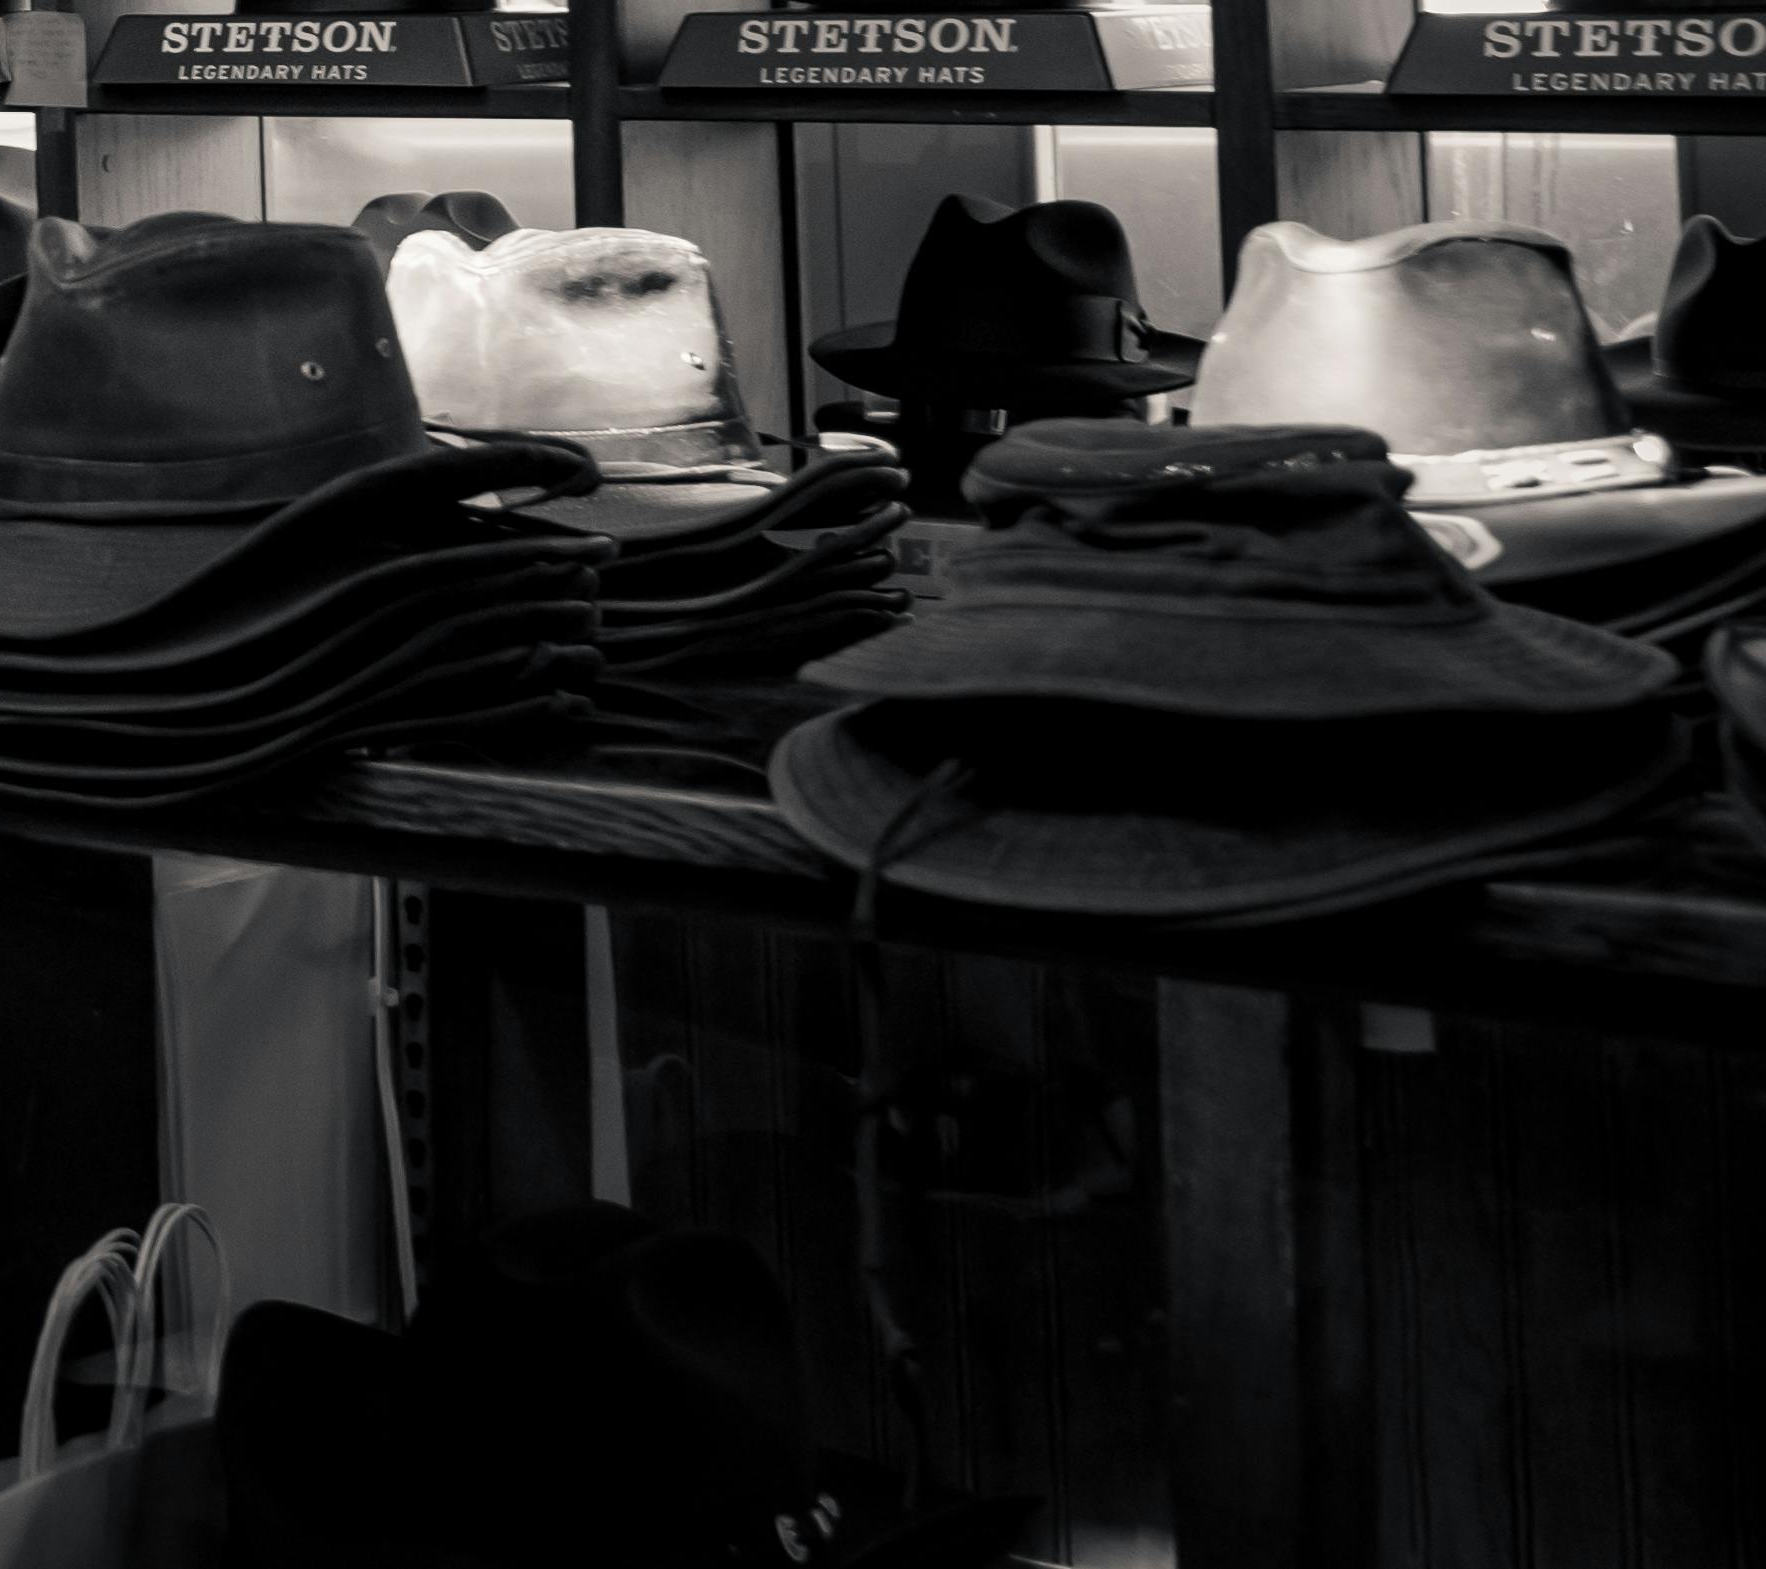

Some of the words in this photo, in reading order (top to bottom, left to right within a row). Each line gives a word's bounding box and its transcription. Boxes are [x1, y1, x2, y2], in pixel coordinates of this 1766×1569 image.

[161, 20, 398, 54] STETSON
[737, 17, 1019, 55] STETSON
[1482, 17, 1766, 59] STETSO
[177, 63, 305, 81] LEGENDARY
[310, 63, 369, 81] HATS
[759, 65, 911, 85] LEGENDARY
[918, 65, 986, 85] HATS
[1511, 71, 1697, 92] LEGENDARY
[1707, 71, 1766, 92] HAT
